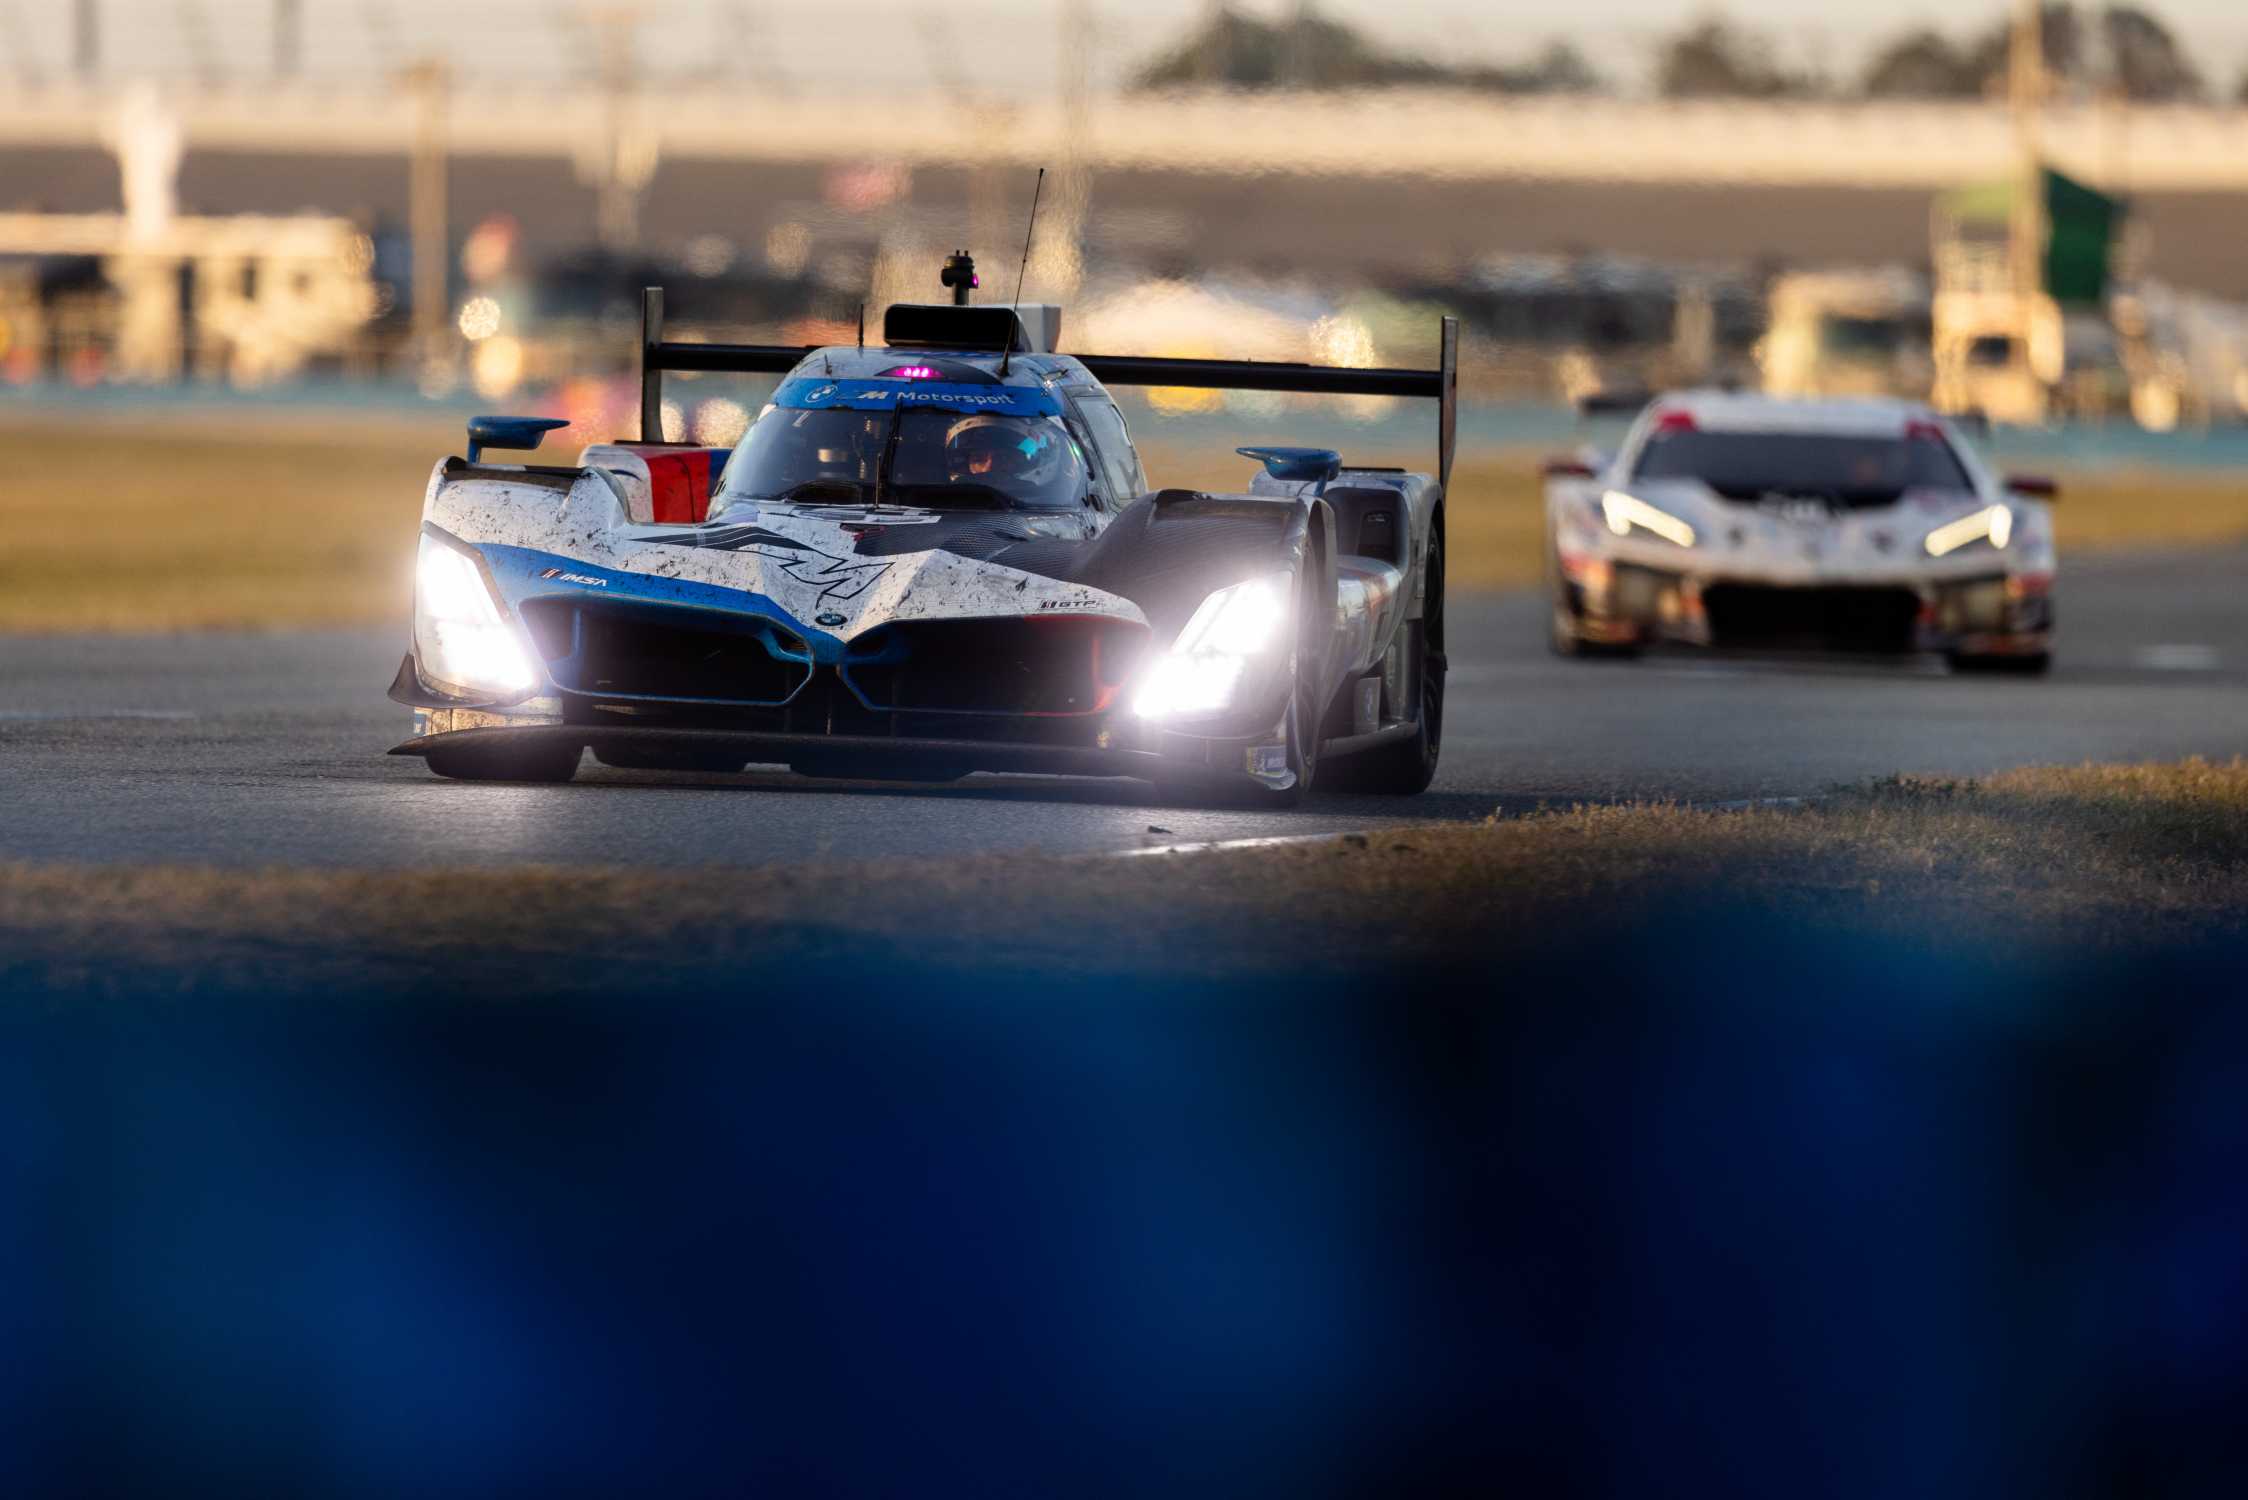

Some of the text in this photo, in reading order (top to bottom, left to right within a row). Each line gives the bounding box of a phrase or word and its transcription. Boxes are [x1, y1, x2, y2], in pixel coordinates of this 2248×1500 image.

[897, 391, 1016, 405] Motorsport
[560, 573, 607, 587] IMSA
[1059, 600, 1097, 608] GTP
